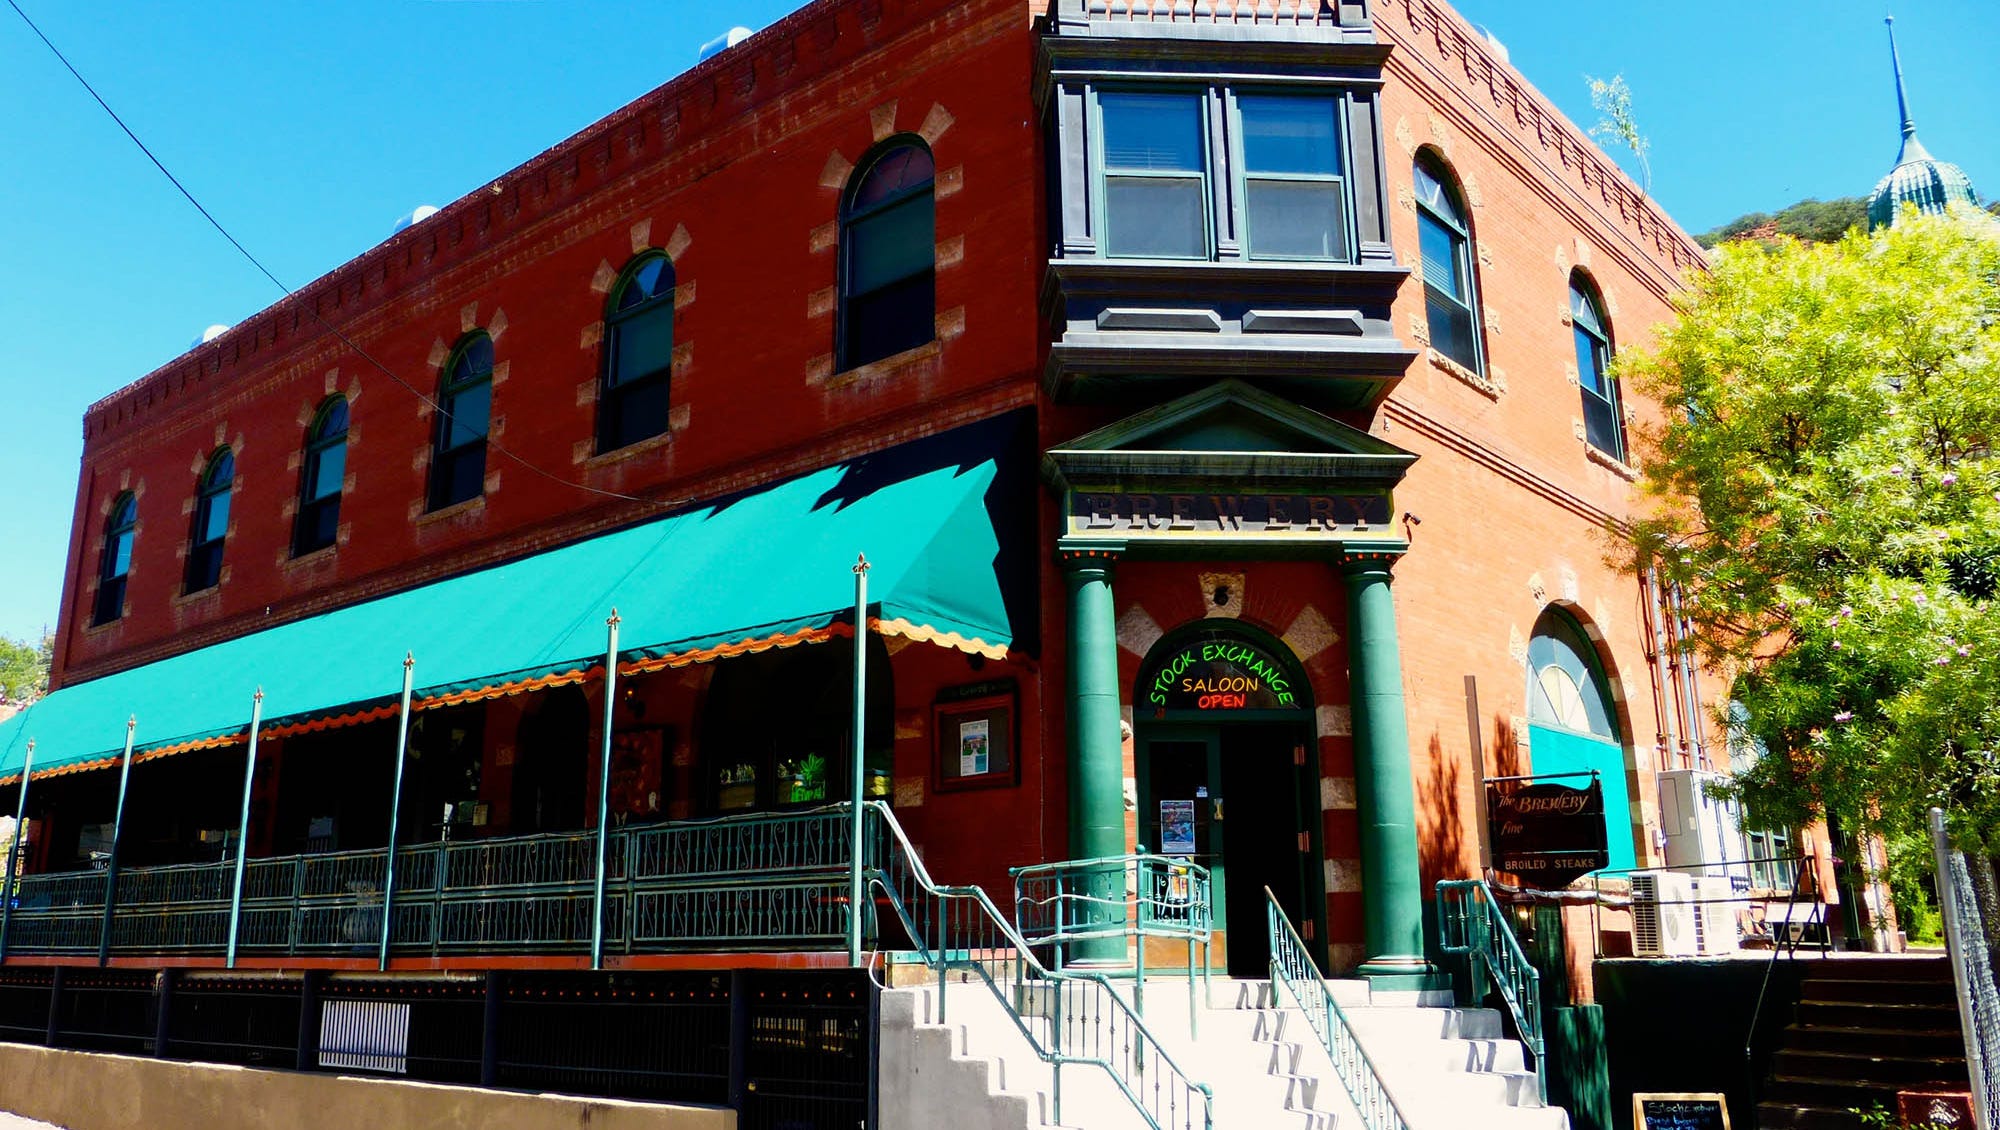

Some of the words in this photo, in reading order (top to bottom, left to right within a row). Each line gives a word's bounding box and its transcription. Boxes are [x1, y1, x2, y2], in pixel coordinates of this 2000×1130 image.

[1086, 495, 1377, 532] BREWERY
[1150, 650, 1197, 706] STOCK
[1202, 644, 1294, 705] EXCHANGE
[1182, 677, 1259, 693] SALOON
[1198, 693, 1246, 710] OPEN
[1499, 795, 1515, 808] The
[1515, 789, 1589, 816] BREWERY
[1501, 821, 1524, 836] fine
[1554, 859, 1595, 869] STEAKS
